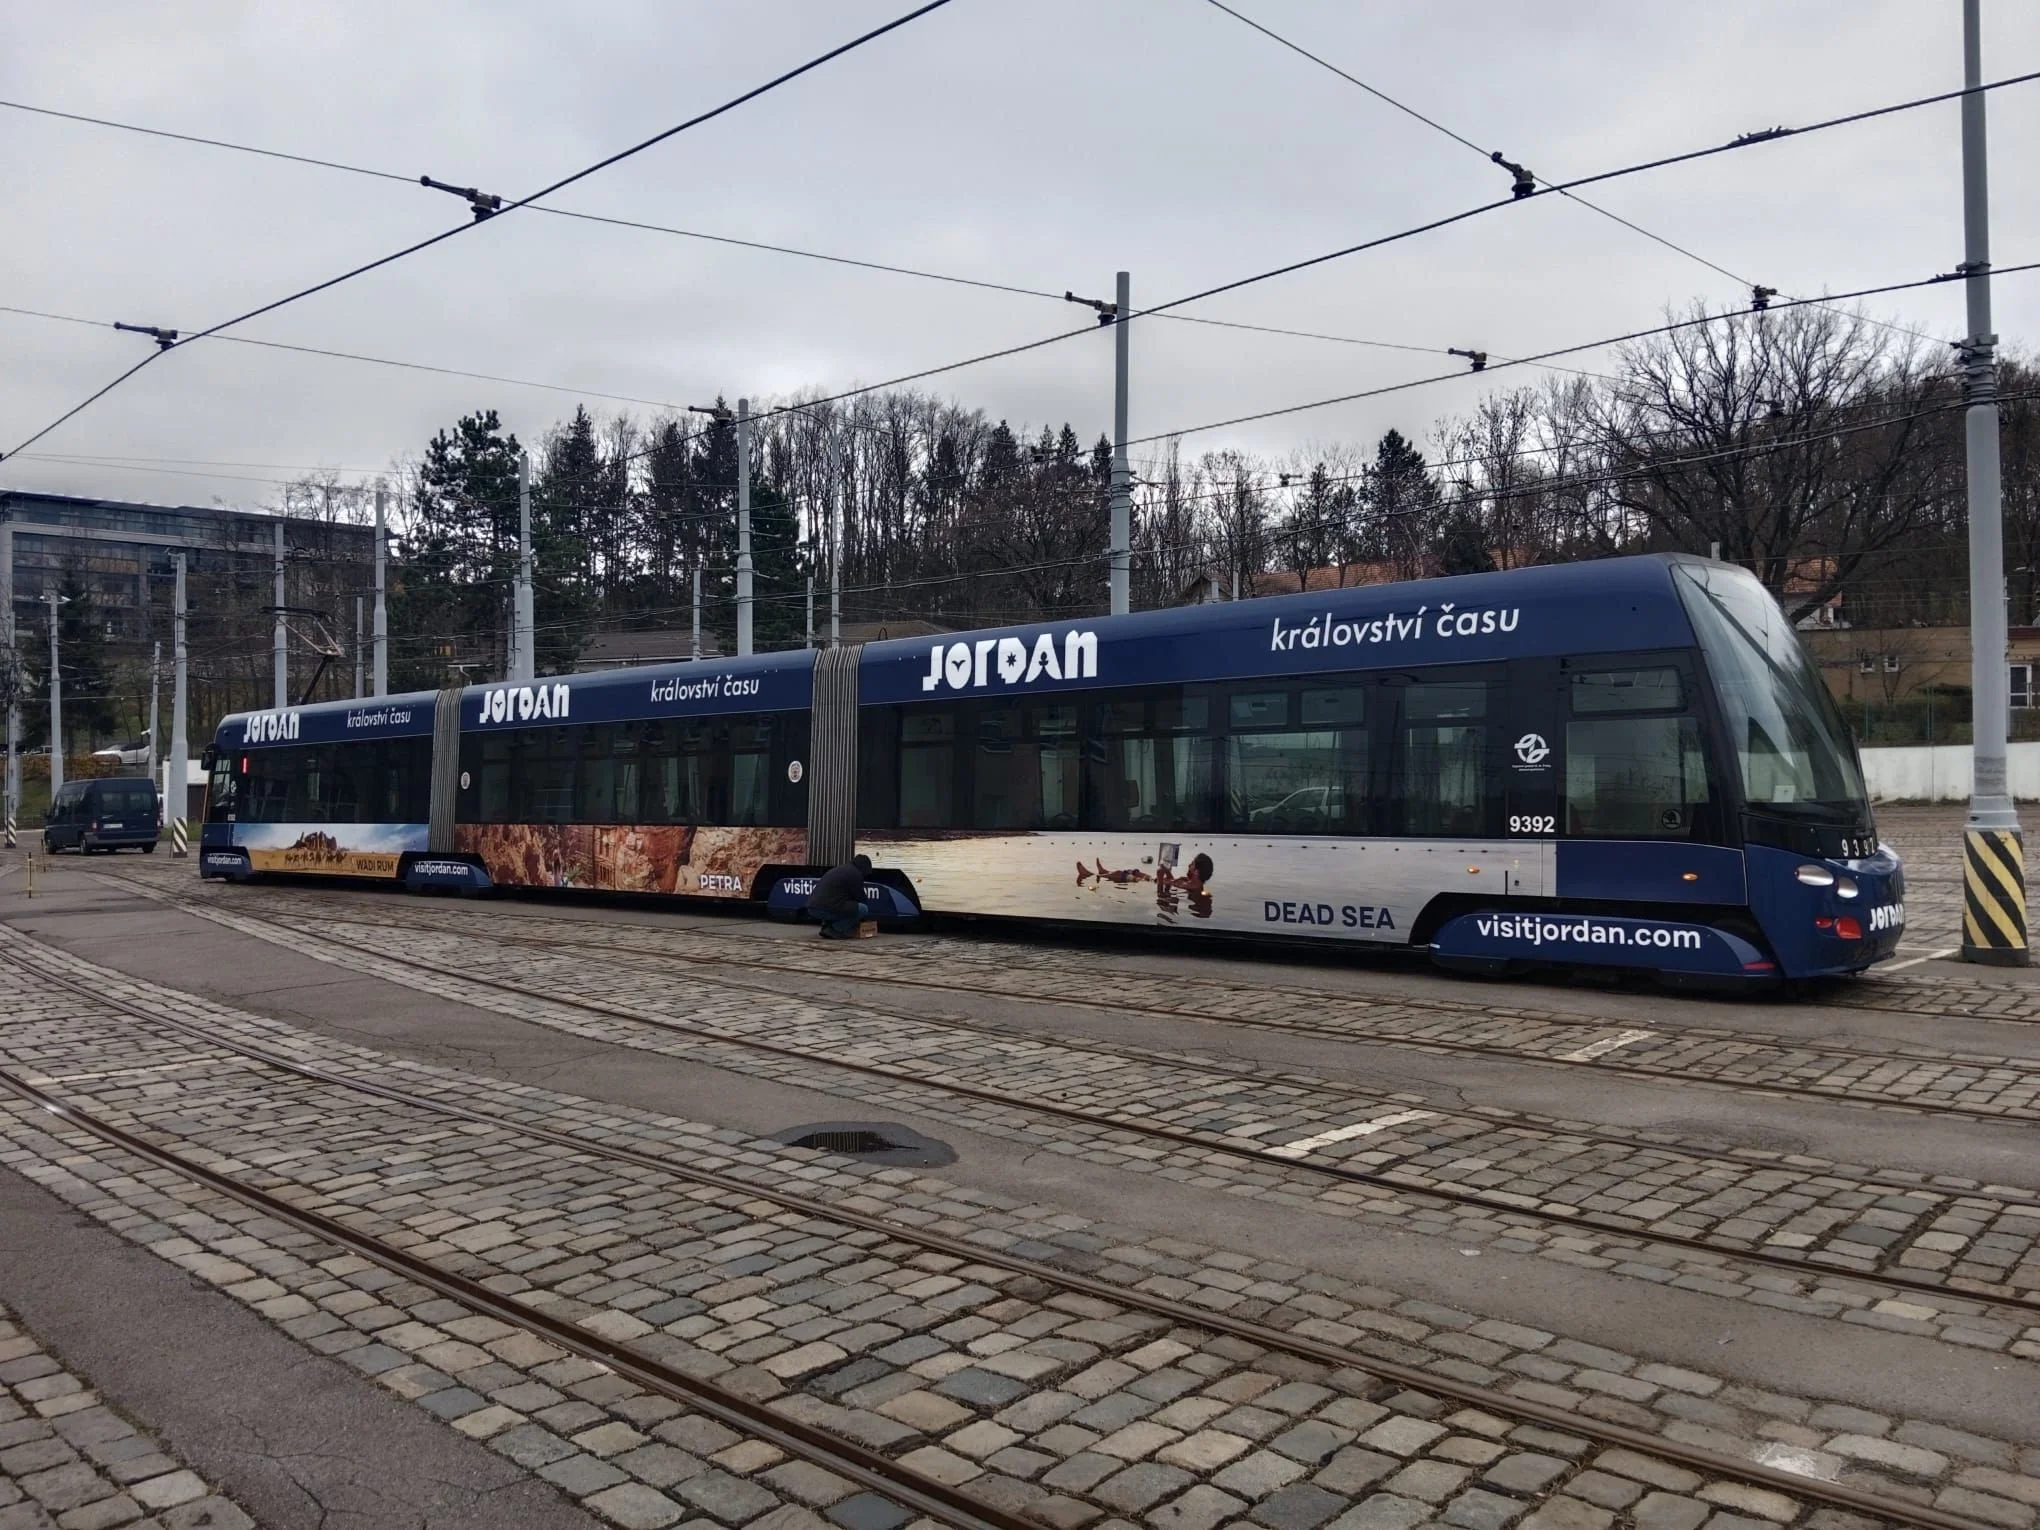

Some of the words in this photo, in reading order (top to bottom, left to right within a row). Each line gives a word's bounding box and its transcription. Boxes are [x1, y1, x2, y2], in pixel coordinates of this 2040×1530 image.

[1271, 606, 1427, 651] království
[1436, 603, 1520, 638] času
[650, 675, 720, 702] království
[723, 674, 759, 696] času
[1509, 815, 1555, 833] 9392
[357, 859, 376, 871] WADI
[377, 860, 394, 872] RUM
[414, 861, 468, 876] visitjordan.com
[700, 874, 742, 891] PETRA
[1264, 901, 1334, 926] DEAD
[1341, 906, 1396, 930] SEA
[1477, 915, 1701, 949] visitjordan.com
